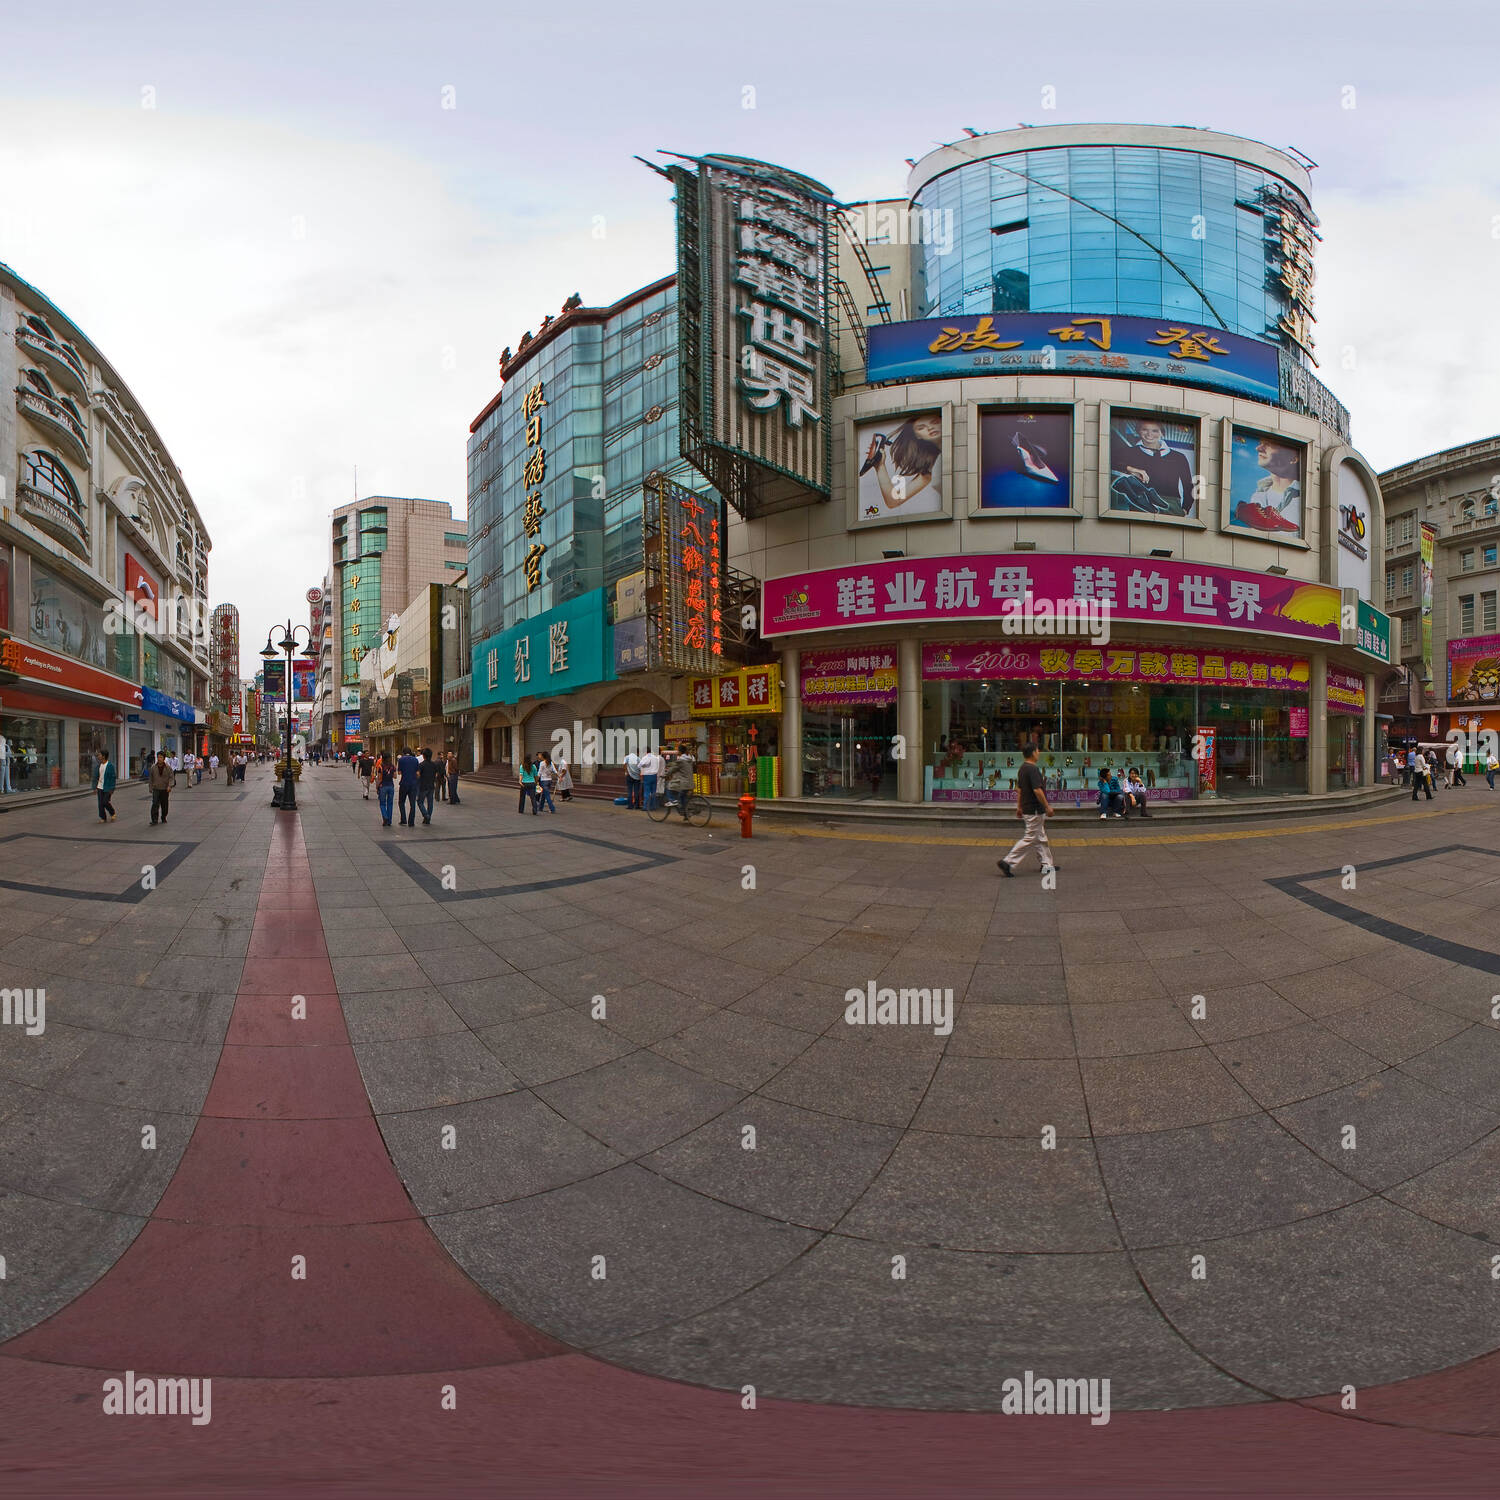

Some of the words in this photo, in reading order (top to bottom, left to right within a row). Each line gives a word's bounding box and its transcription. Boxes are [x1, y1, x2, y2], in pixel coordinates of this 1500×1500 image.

[928, 317, 1231, 362] 波司登
[1066, 354, 1130, 369] 六楼
[837, 566, 1034, 618] 鞋业航母
[1072, 564, 1264, 622] 鞋的世界
[486, 621, 570, 691] 世纪隆
[966, 652, 1030, 670] 2008
[695, 677, 768, 704] 桂發祥
